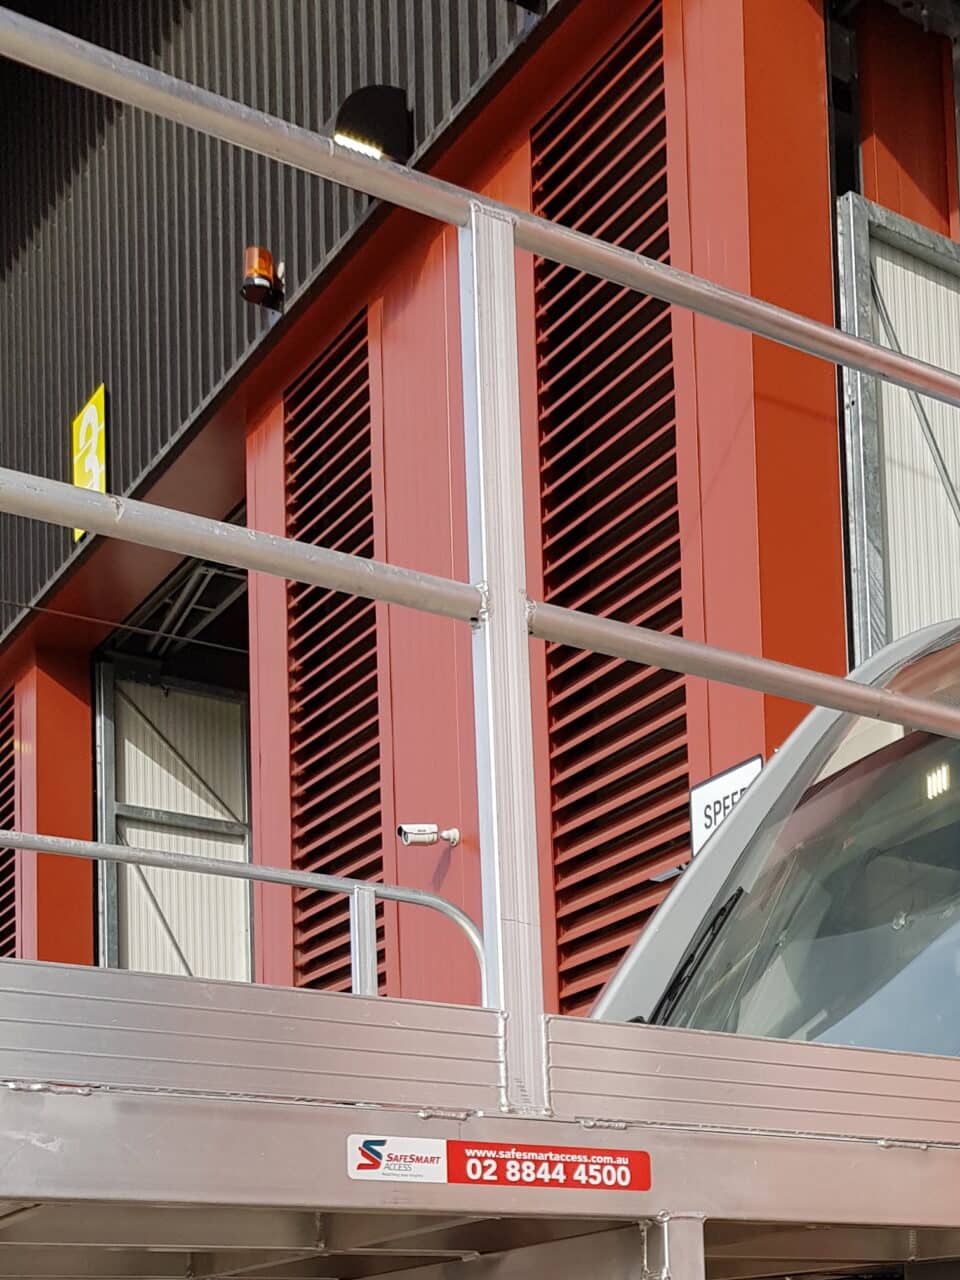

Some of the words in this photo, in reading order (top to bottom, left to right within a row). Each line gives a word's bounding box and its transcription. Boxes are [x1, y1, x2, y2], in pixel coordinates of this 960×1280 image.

[464, 1147, 629, 1165] www.safesmartaccess.com.au
[383, 1163, 413, 1172] ACCESS
[466, 1158, 498, 1181] 02
[505, 1160, 567, 1184] 8844
[573, 1163, 631, 1187] 4500
